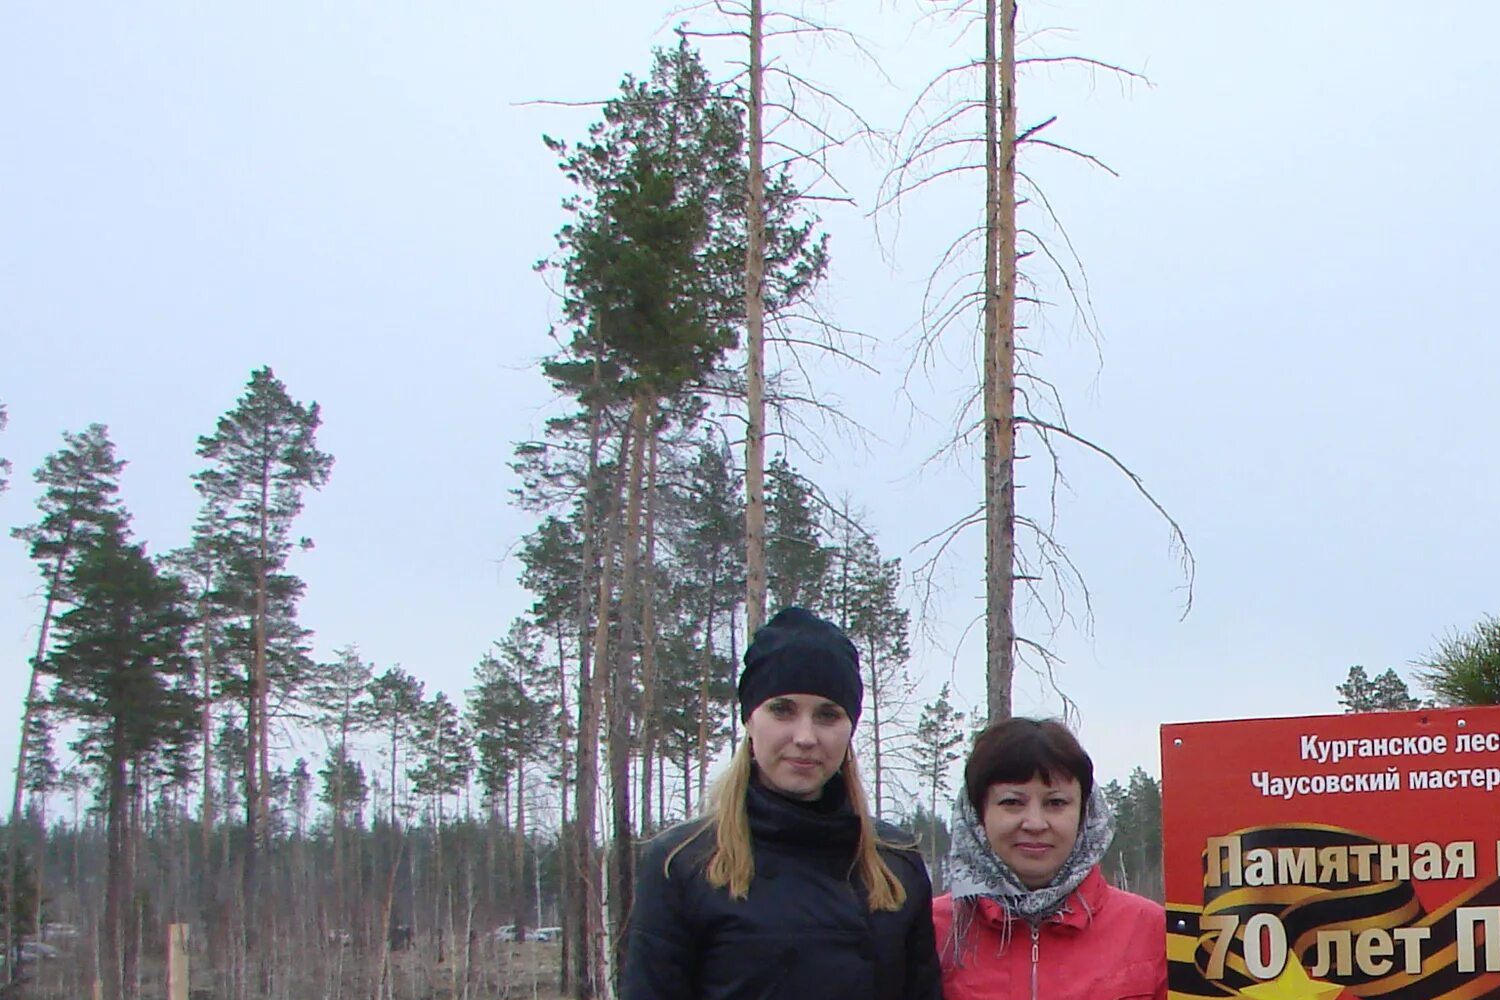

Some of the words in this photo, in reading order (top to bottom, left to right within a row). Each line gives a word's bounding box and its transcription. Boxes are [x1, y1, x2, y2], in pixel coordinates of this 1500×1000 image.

[1301, 732, 1447, 763] Курганское
[1251, 767, 1400, 799] Чаусовский
[1207, 836, 1475, 887] Памятная
[1200, 912, 1287, 979] 70
[1311, 927, 1431, 977] лет
